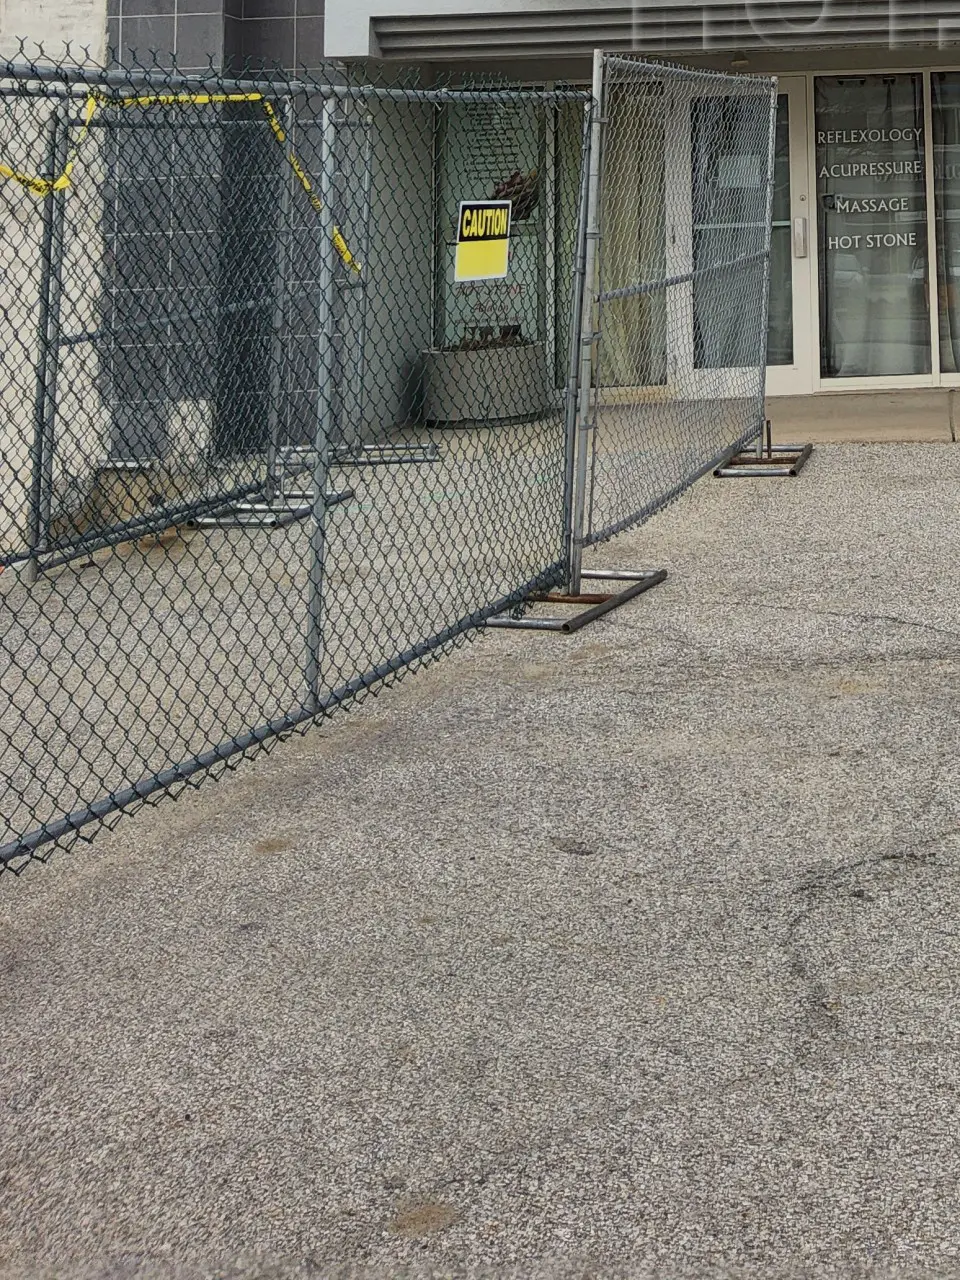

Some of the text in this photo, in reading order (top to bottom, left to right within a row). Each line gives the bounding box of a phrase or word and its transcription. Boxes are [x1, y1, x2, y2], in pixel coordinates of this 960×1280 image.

[817, 128, 922, 144] REFLEXOLOGY
[819, 161, 922, 178] ACUPRESSURE
[836, 198, 909, 213] MASSAGE
[462, 208, 508, 238] CAUTION
[828, 233, 917, 250] HOT STONE
